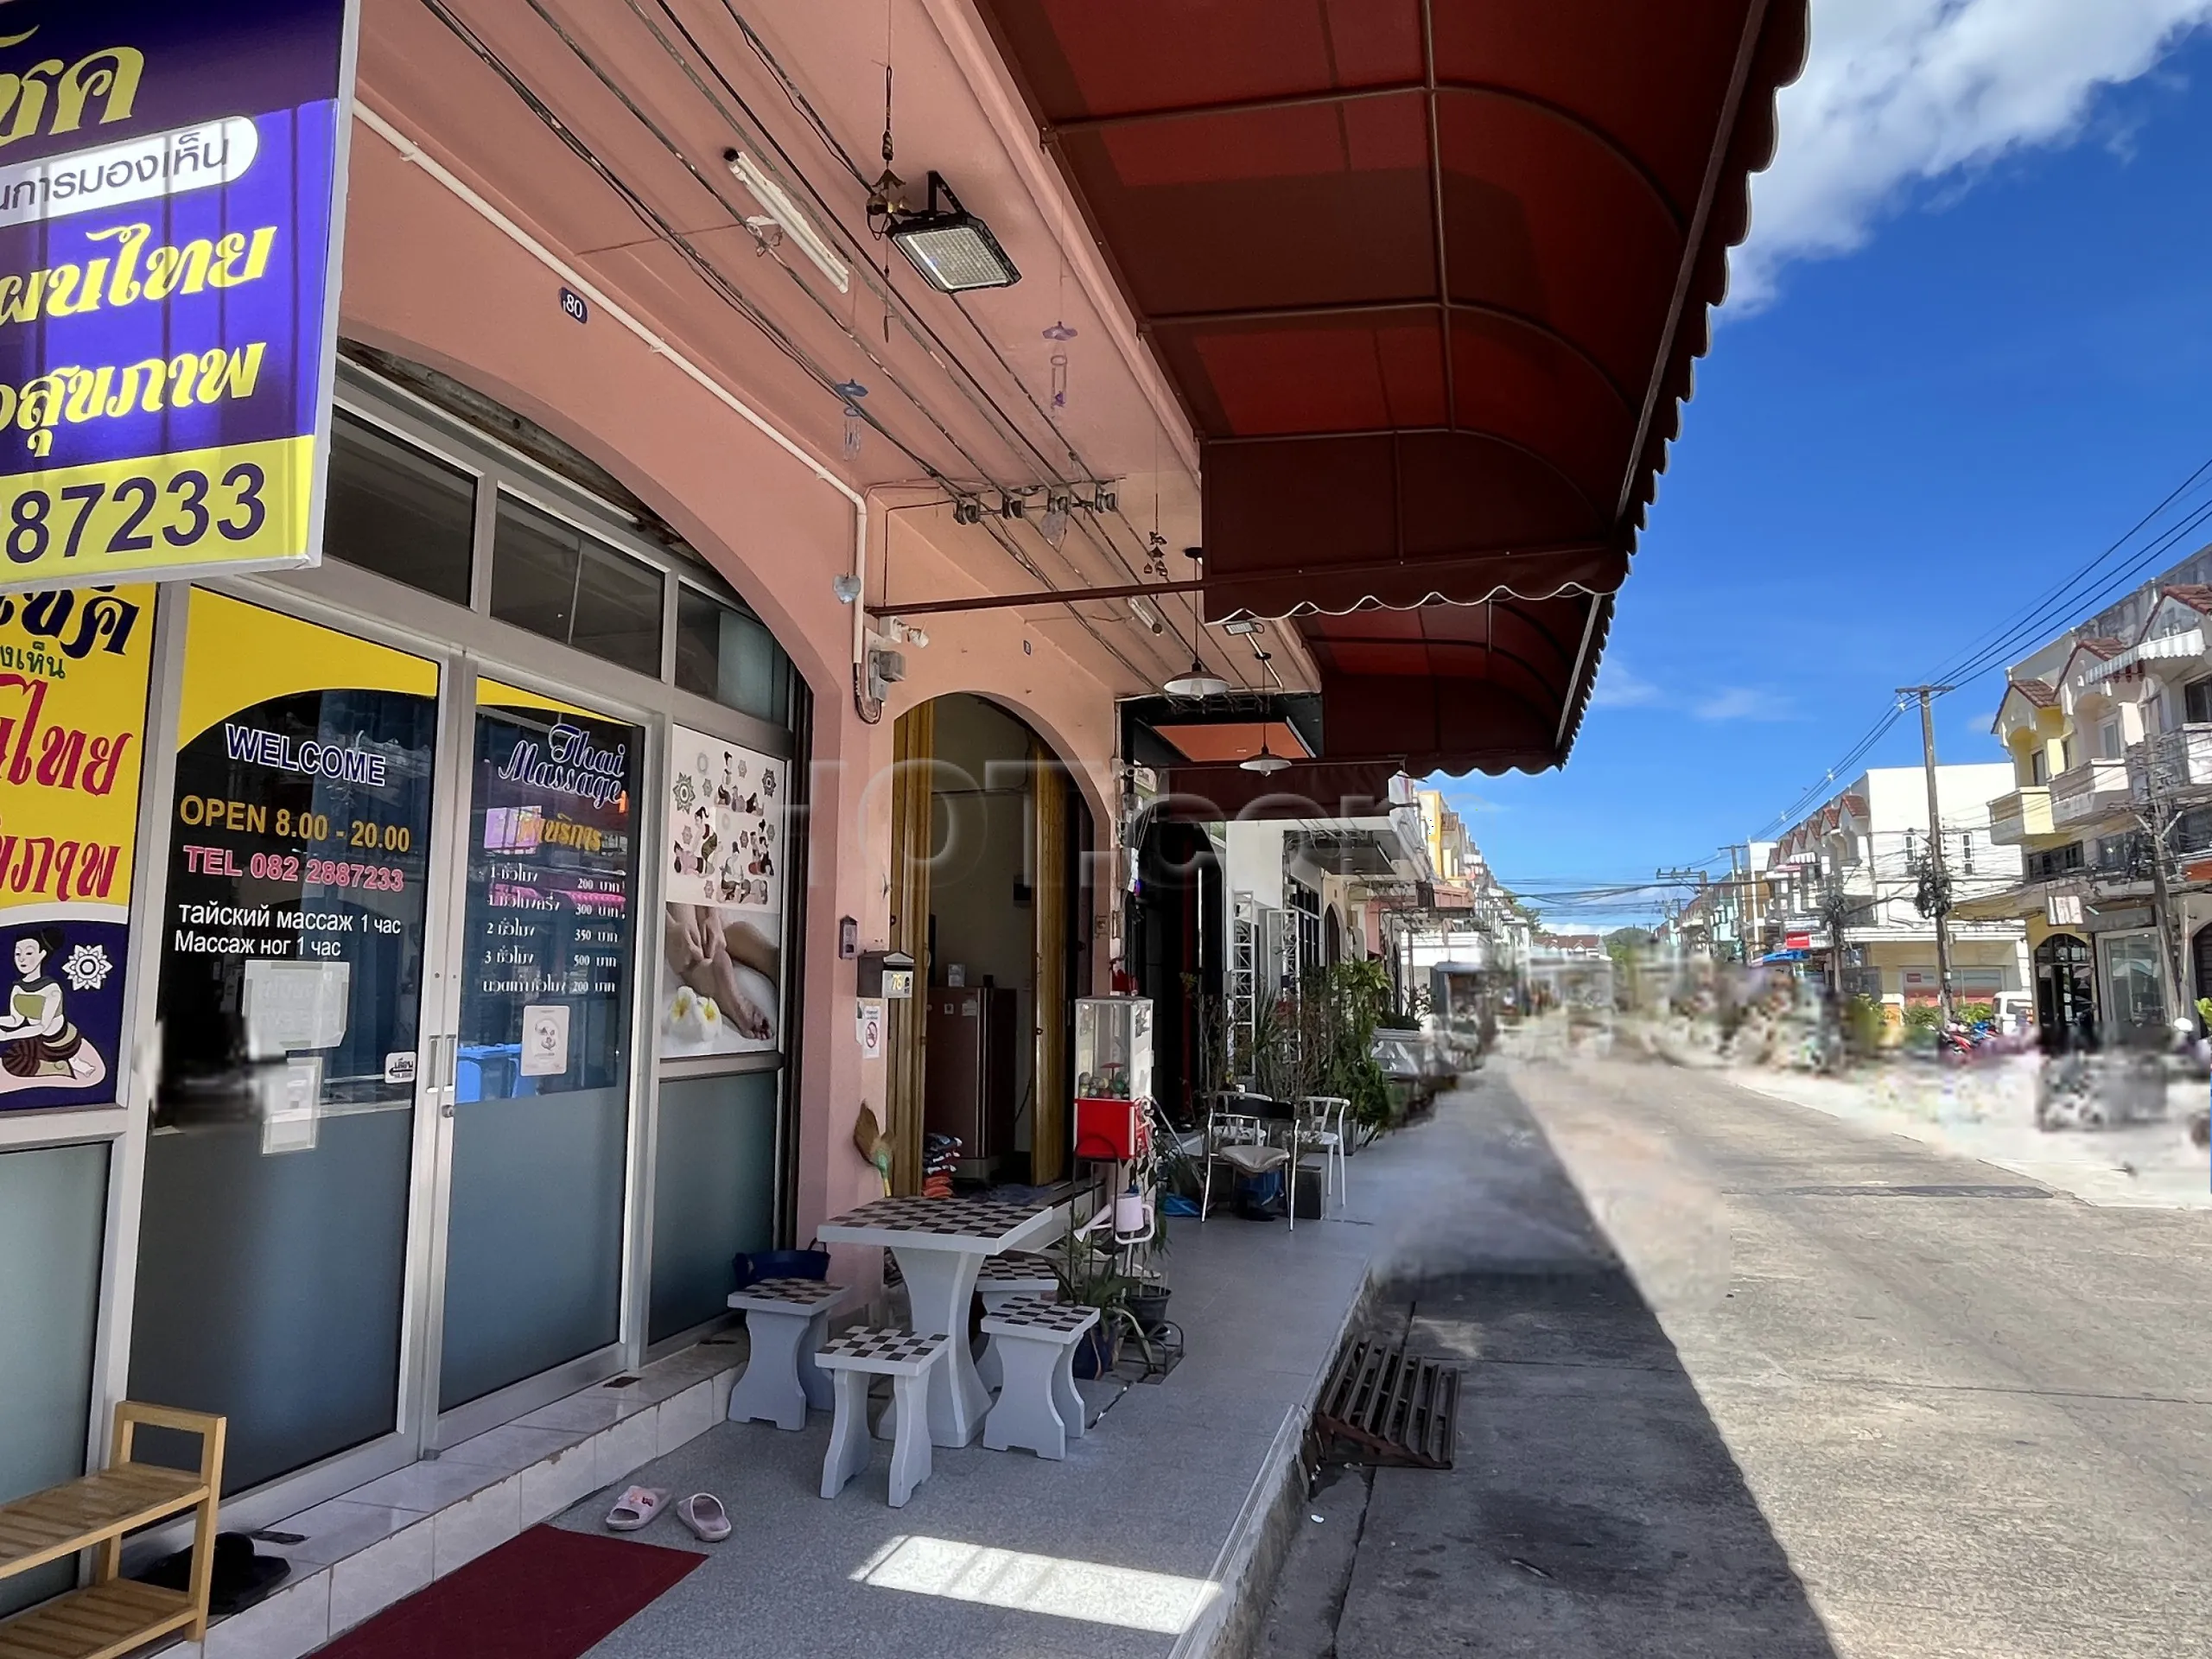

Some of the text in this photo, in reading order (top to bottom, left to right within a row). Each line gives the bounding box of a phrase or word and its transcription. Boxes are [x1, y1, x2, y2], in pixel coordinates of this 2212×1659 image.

[5, 462, 266, 564] 87233
[225, 723, 386, 787] WELCOME
[548, 722, 625, 778] Thai
[498, 740, 622, 810] Massage
[180, 795, 267, 834] OPEN
[276, 809, 328, 842] 8.00
[350, 820, 410, 852] 20.00
[182, 845, 404, 893] TEL 082 2887233
[577, 878, 594, 890] 200
[276, 910, 353, 931] массаж
[360, 913, 368, 933] 1
[374, 918, 401, 934] час
[575, 904, 593, 916] 300
[175, 930, 341, 957] Массаж ног 1 час
[486, 922, 494, 934] 2
[574, 929, 592, 942] 350
[484, 950, 492, 964] 3
[574, 955, 590, 967] 500
